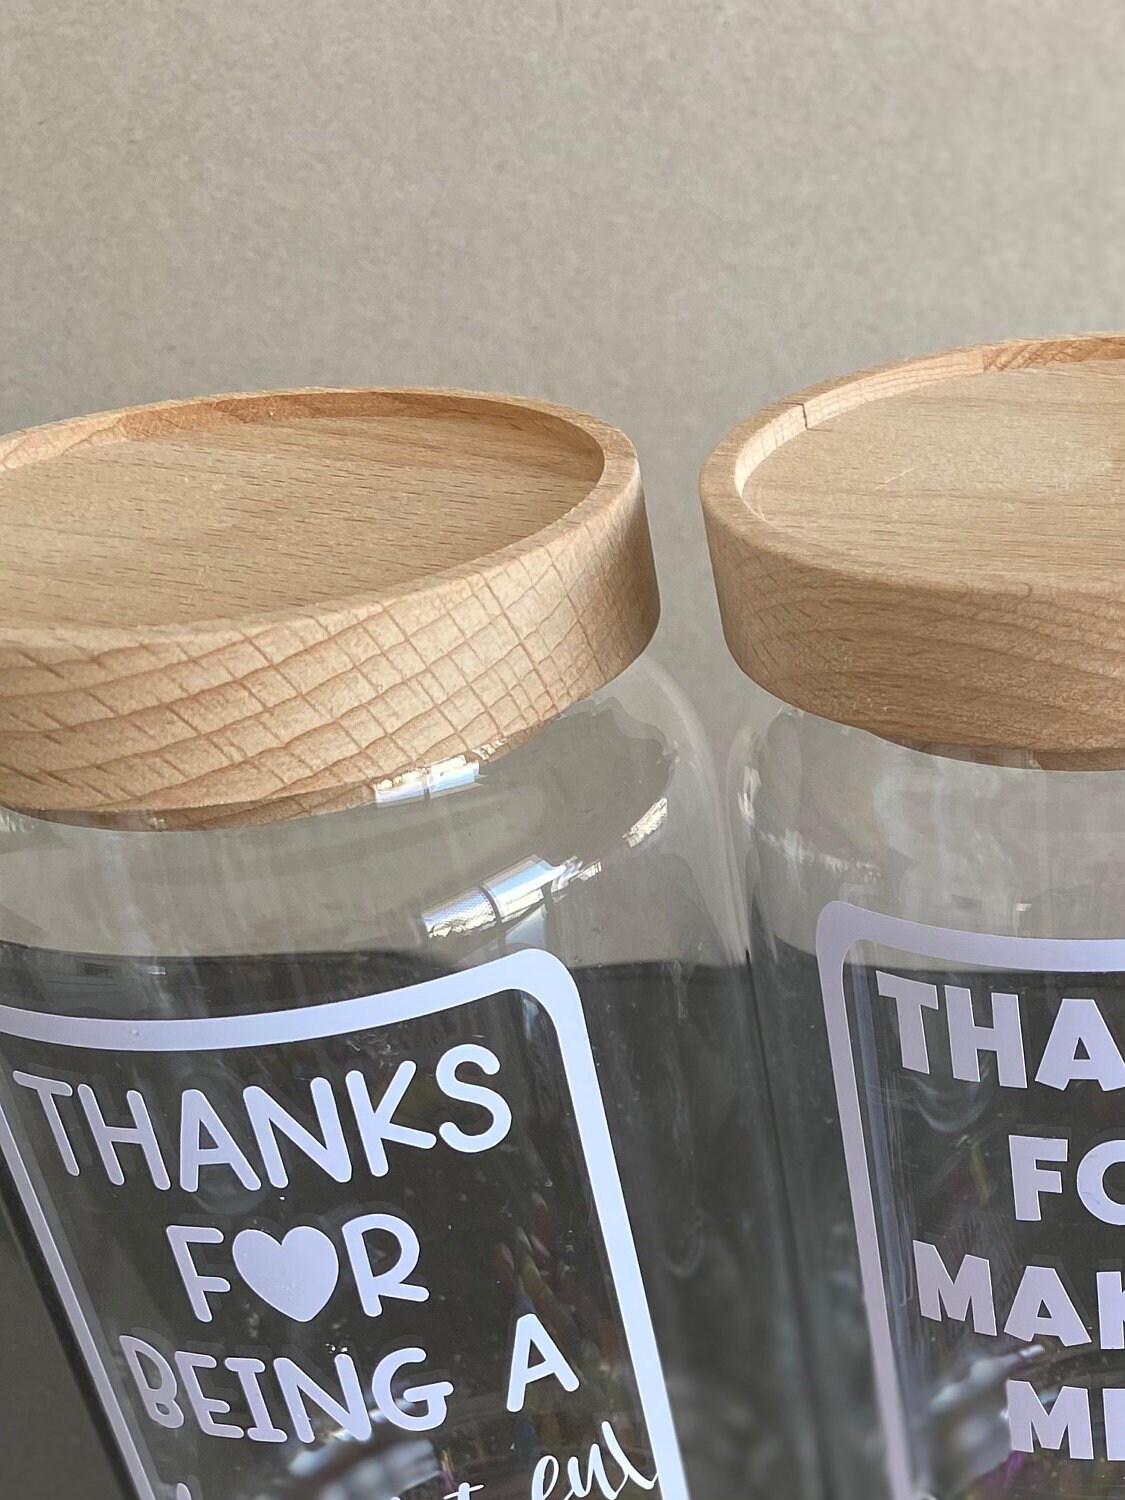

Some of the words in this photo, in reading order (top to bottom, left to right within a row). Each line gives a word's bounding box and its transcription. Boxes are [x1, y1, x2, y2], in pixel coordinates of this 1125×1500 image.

[13, 1043, 512, 1193] THANKS
[120, 1335, 454, 1443] BEING
[506, 1313, 580, 1411] A
